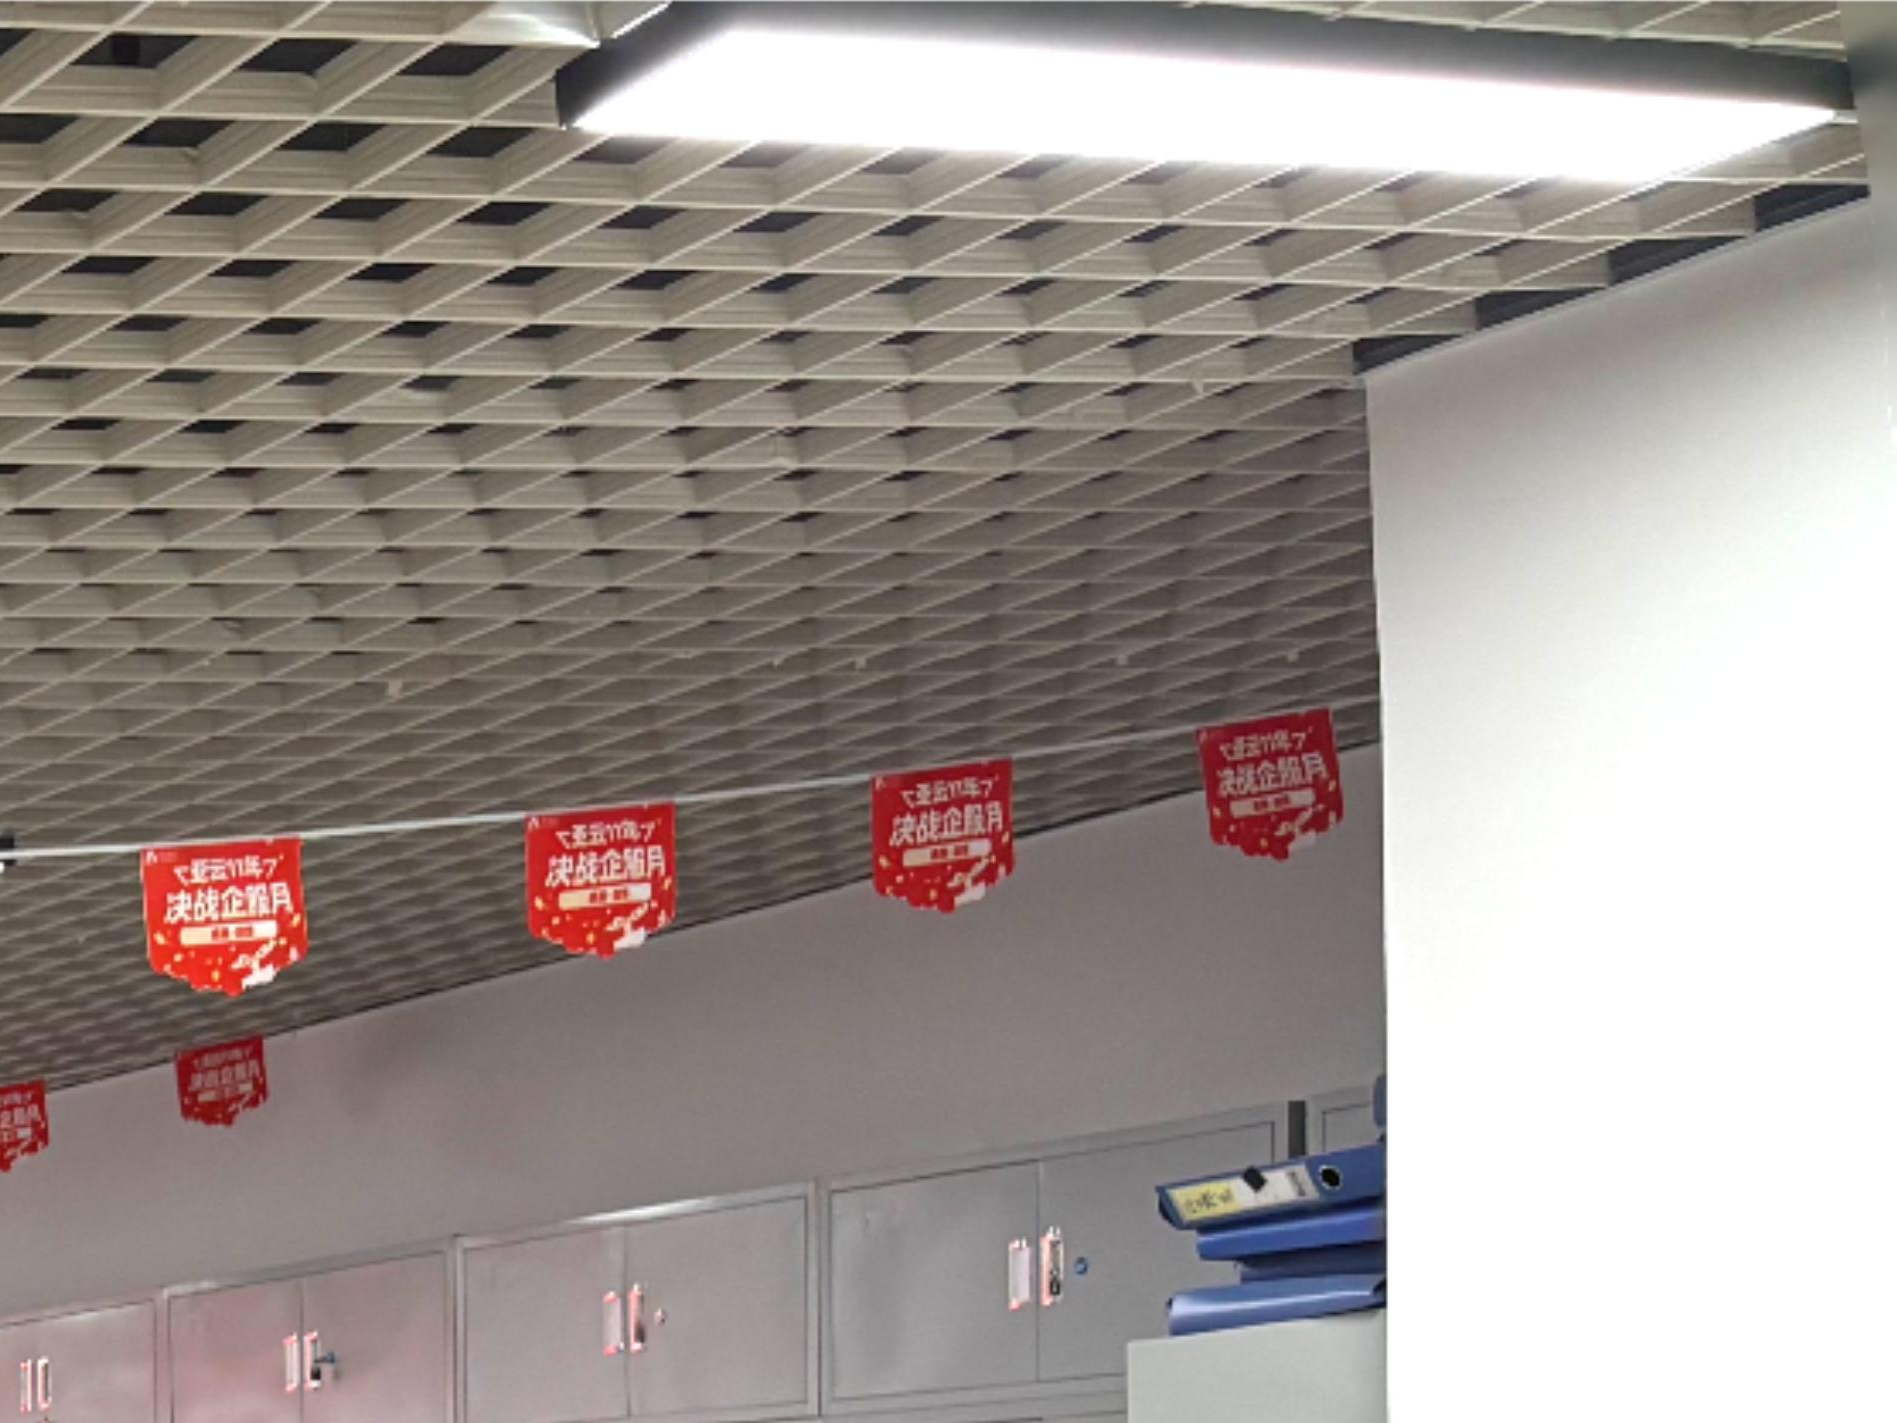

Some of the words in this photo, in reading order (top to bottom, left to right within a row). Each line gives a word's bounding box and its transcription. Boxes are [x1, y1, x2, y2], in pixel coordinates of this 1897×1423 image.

[1216, 751, 1327, 798] 决战企服月
[889, 801, 1002, 847] 决战企服月
[545, 845, 665, 887] 决战企服月
[164, 882, 293, 924] 决战企服月
